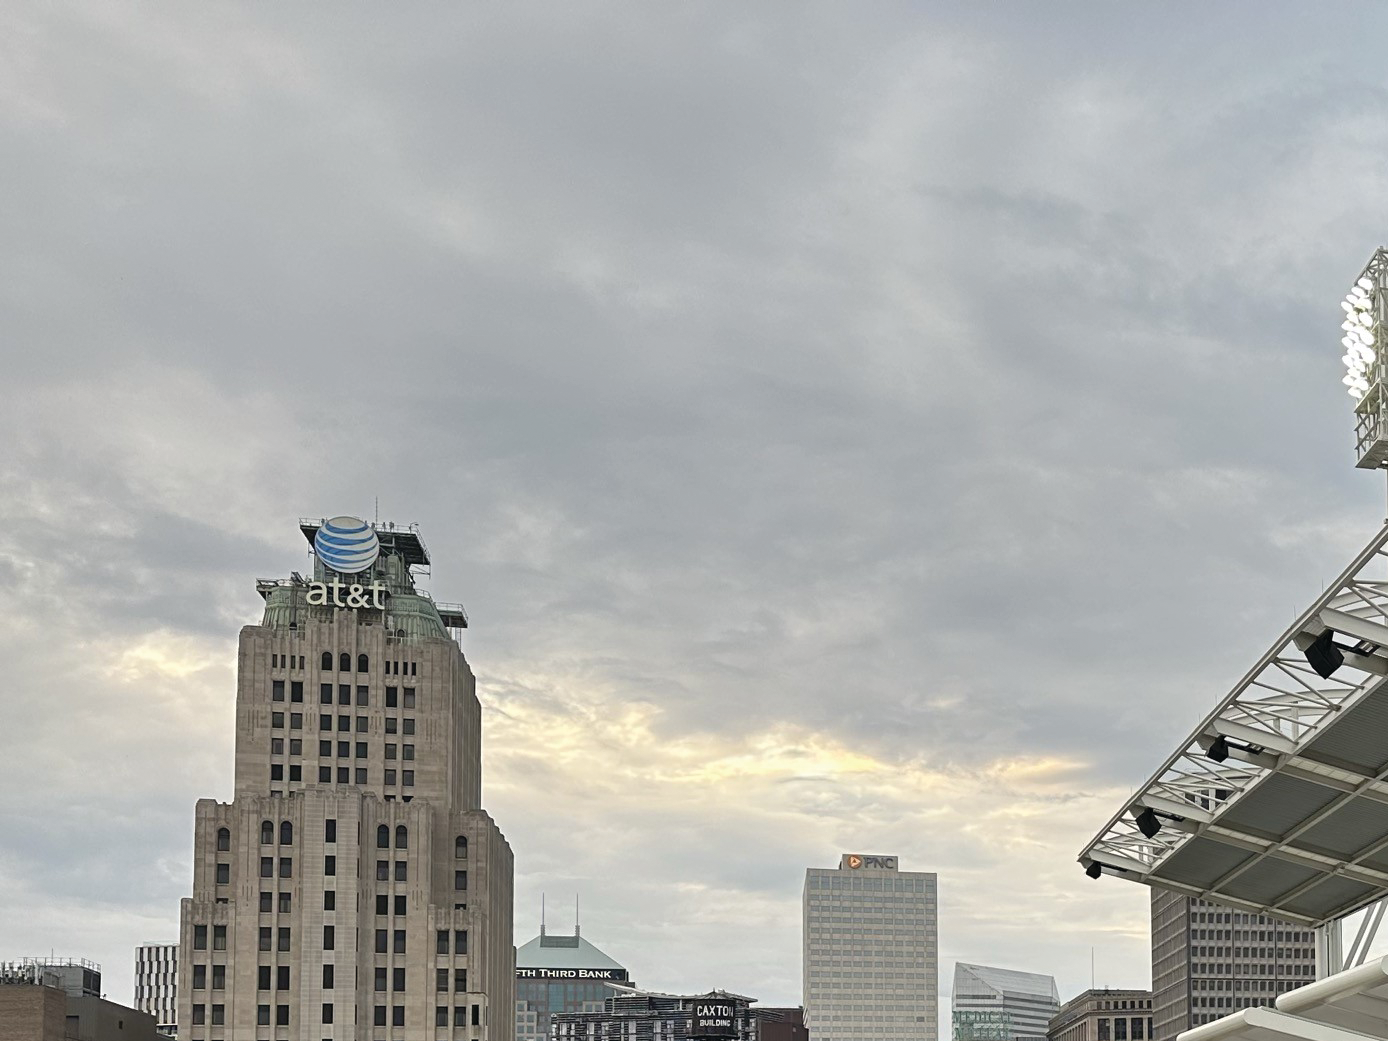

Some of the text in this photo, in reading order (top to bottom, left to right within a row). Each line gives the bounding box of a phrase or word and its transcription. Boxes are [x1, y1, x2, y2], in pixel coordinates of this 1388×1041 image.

[306, 577, 385, 609] at&t
[864, 857, 894, 869] PNC
[697, 1005, 734, 1017] CAXTON
[699, 1019, 731, 1027] BUILDING
